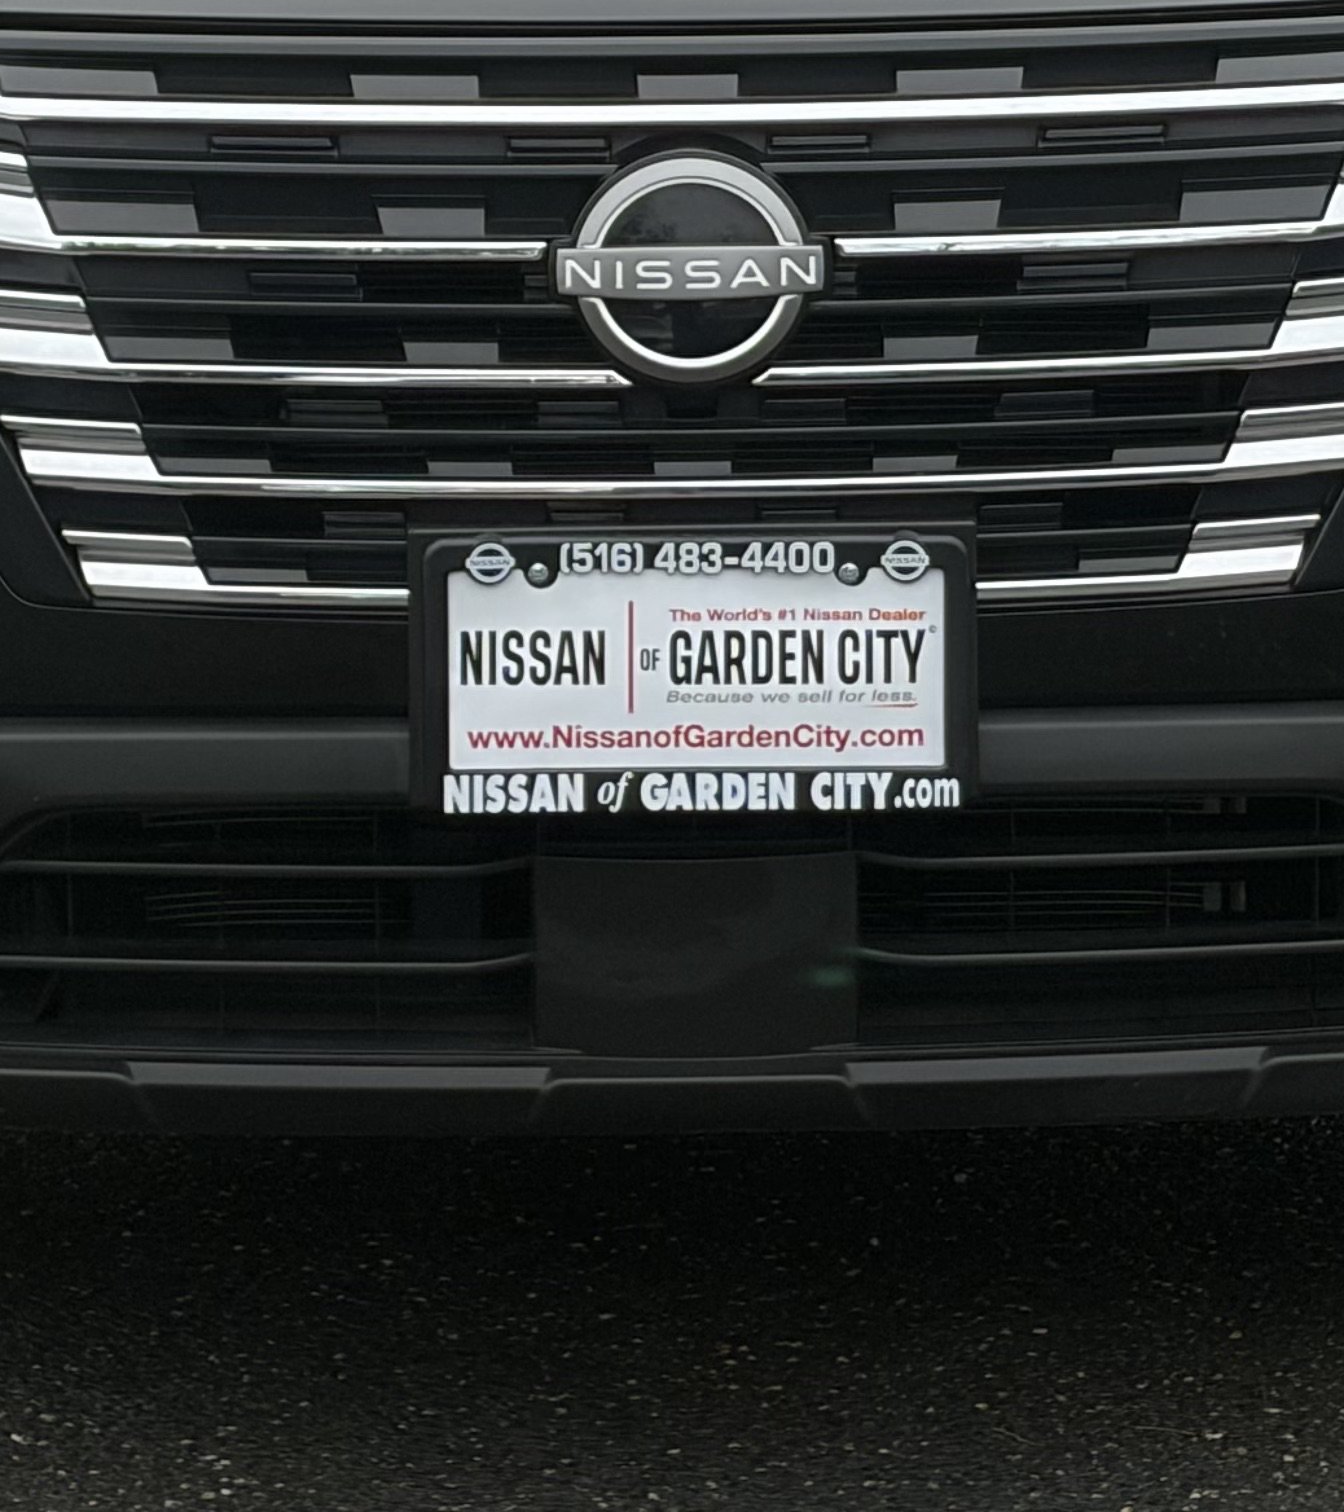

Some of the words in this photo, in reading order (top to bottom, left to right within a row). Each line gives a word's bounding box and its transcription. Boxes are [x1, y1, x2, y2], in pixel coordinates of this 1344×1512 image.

[564, 255, 817, 290] NISSAN
[469, 557, 511, 567] NISSAN
[559, 541, 645, 574] (516)
[653, 541, 836, 575] 483-4400
[883, 555, 927, 565] NISSAN
[669, 608, 702, 622] The
[706, 608, 773, 622] World's
[777, 608, 797, 621] #1
[803, 608, 864, 621] Nissan
[868, 607, 927, 621] Dealer
[460, 630, 606, 686] NISSAN
[640, 648, 660, 672] OF
[669, 629, 825, 686] GARDEN
[837, 628, 926, 685] CITY
[666, 689, 754, 704] Because
[760, 692, 791, 704] we
[798, 690, 832, 704] sell
[838, 690, 867, 703] for
[871, 689, 918, 703] less.
[467, 724, 925, 753] www.NissanofGardenCity.com
[443, 773, 585, 814] NISSAN
[597, 771, 635, 813] of
[640, 772, 796, 811] GARDEN
